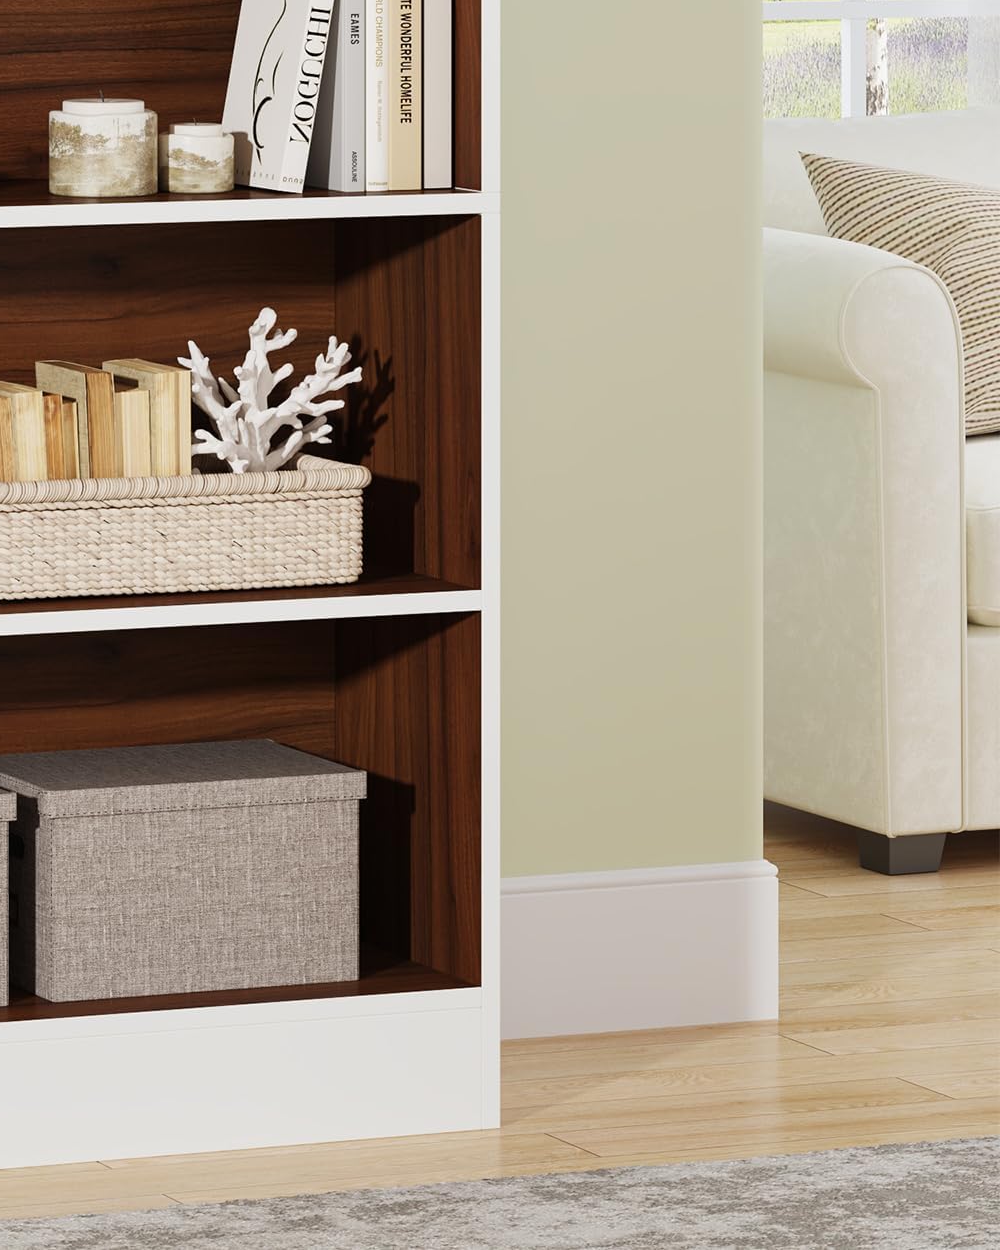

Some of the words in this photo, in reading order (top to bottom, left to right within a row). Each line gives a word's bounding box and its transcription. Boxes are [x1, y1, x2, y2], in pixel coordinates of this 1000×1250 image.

[350, 13, 360, 45] EAMES
[374, 16, 384, 68] CHAMPIONS
[399, 13, 412, 74] WONDERFUL
[399, 75, 412, 124] HOMELIFE
[350, 150, 358, 183] ASSOULINE
